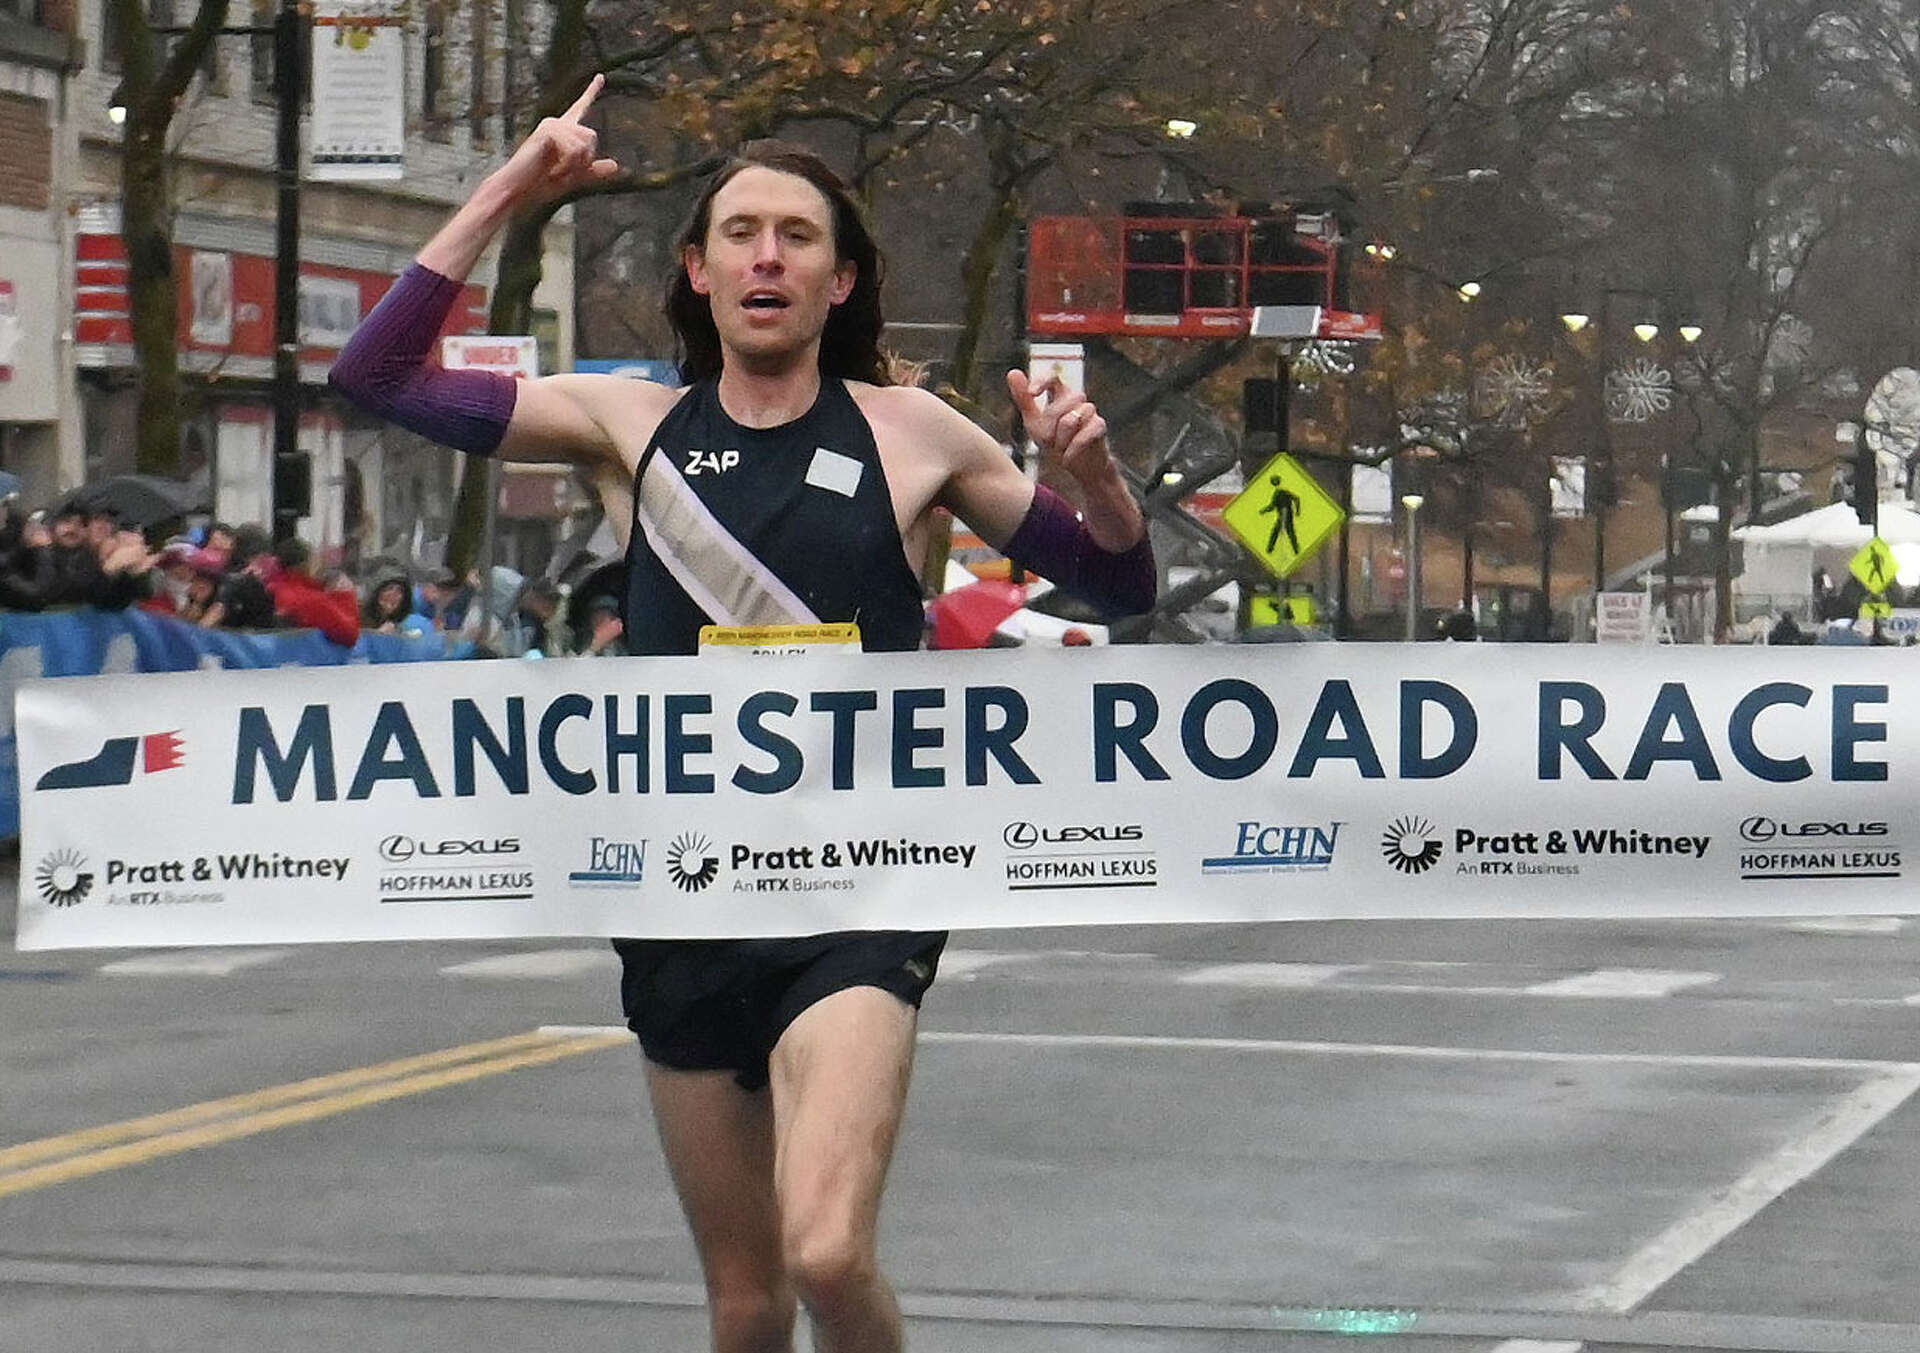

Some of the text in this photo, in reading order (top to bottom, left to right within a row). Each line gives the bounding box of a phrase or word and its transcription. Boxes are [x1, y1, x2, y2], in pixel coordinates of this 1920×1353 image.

[684, 450, 740, 476] ZAP
[232, 679, 1888, 804] MANCHESTER ROAD RACE
[1042, 825, 1143, 842] LEXUS
[1781, 823, 1888, 836] LEXUS
[419, 839, 520, 855] LEXUS
[1234, 821, 1348, 860] ECHN
[1456, 829, 1711, 858] Pratt & Whitney
[589, 837, 648, 874] ECHN
[732, 838, 976, 870] Pratt & Whitney
[1741, 852, 1901, 869] HOFFMAN LEXUS
[107, 853, 350, 885] Pratt & Whitney
[1007, 860, 1157, 879] HOFFMAN LEXUS
[1456, 861, 1580, 876] An RTX Business
[380, 872, 533, 891] HOFFMAN LEXUS
[733, 874, 855, 893] An RTX Business
[130, 892, 160, 905] RTX
